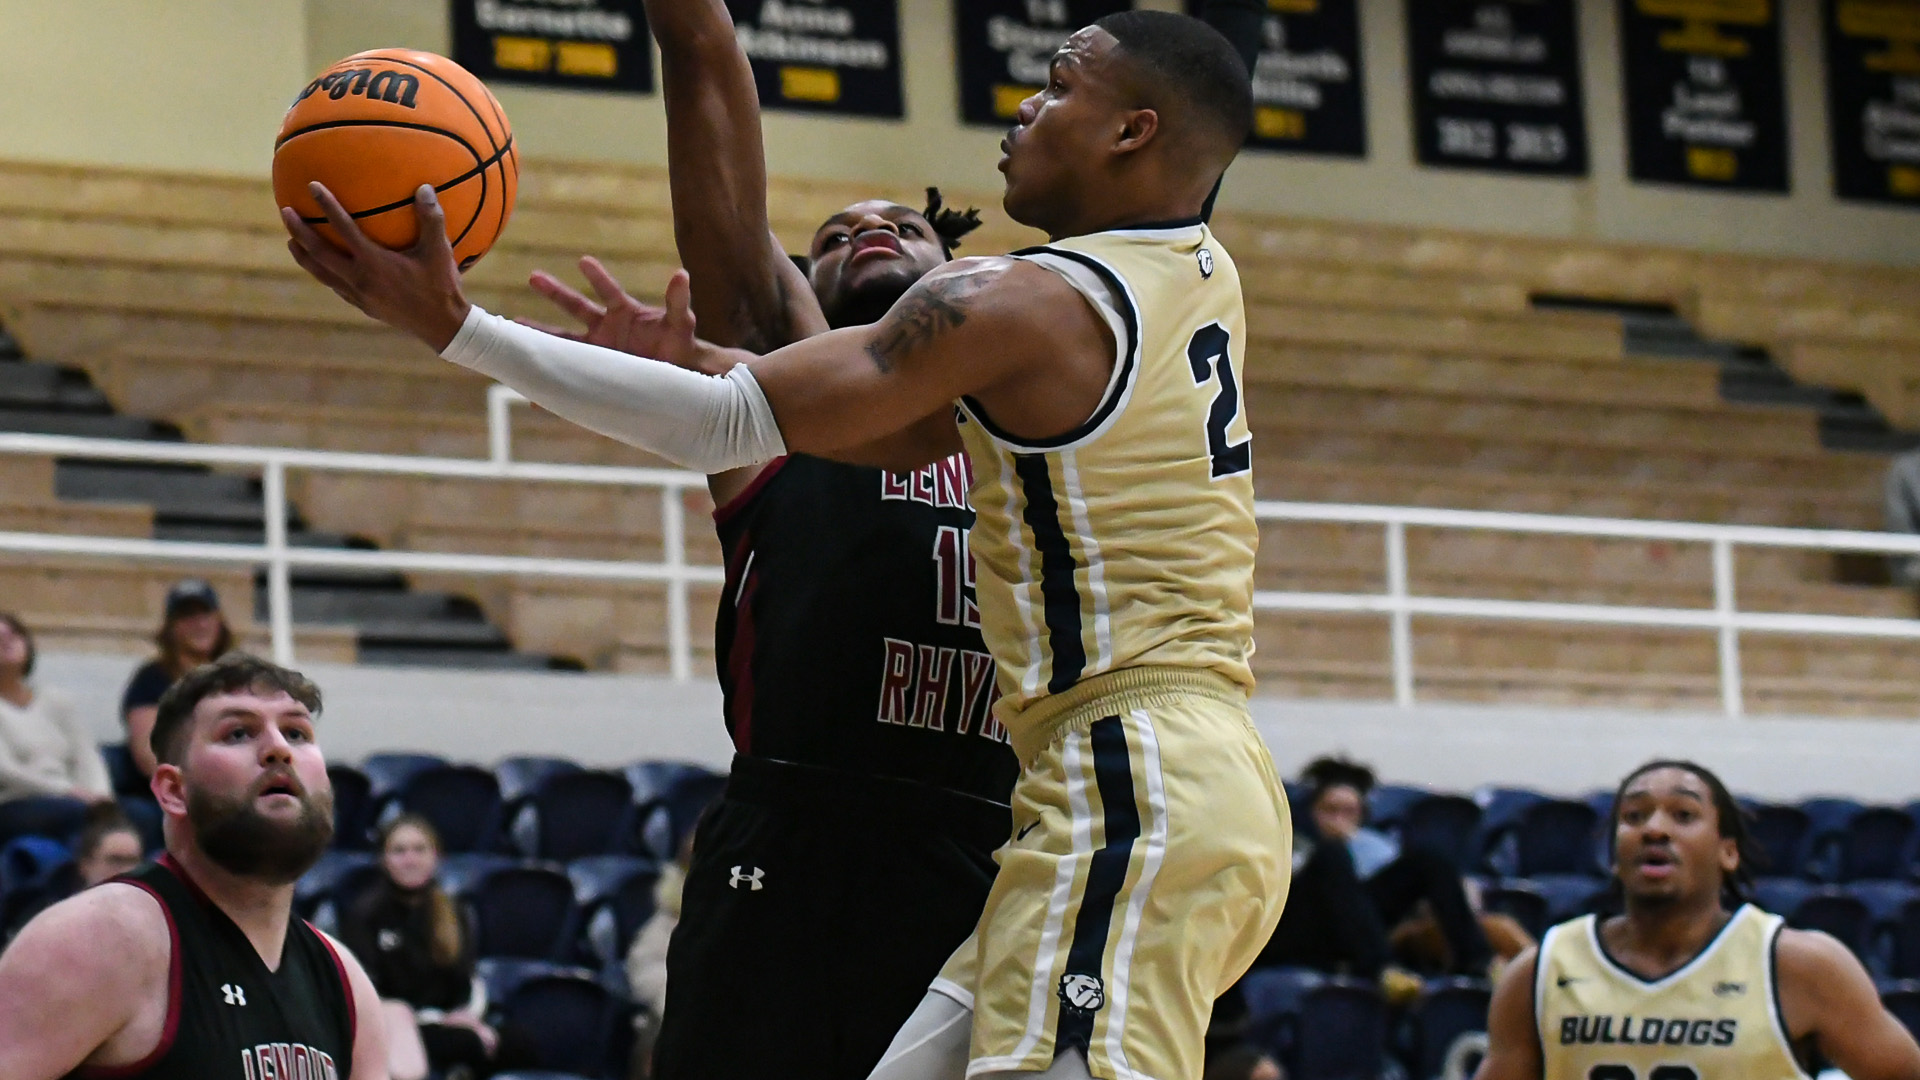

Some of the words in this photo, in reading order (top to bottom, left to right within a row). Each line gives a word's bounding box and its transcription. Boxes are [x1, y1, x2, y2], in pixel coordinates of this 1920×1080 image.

[288, 69, 419, 110] Wilso
[1187, 318, 1252, 482] 2
[881, 452, 977, 512] LEN
[877, 637, 1012, 744] RHY
[1560, 1015, 1738, 1046] BULLDOGS
